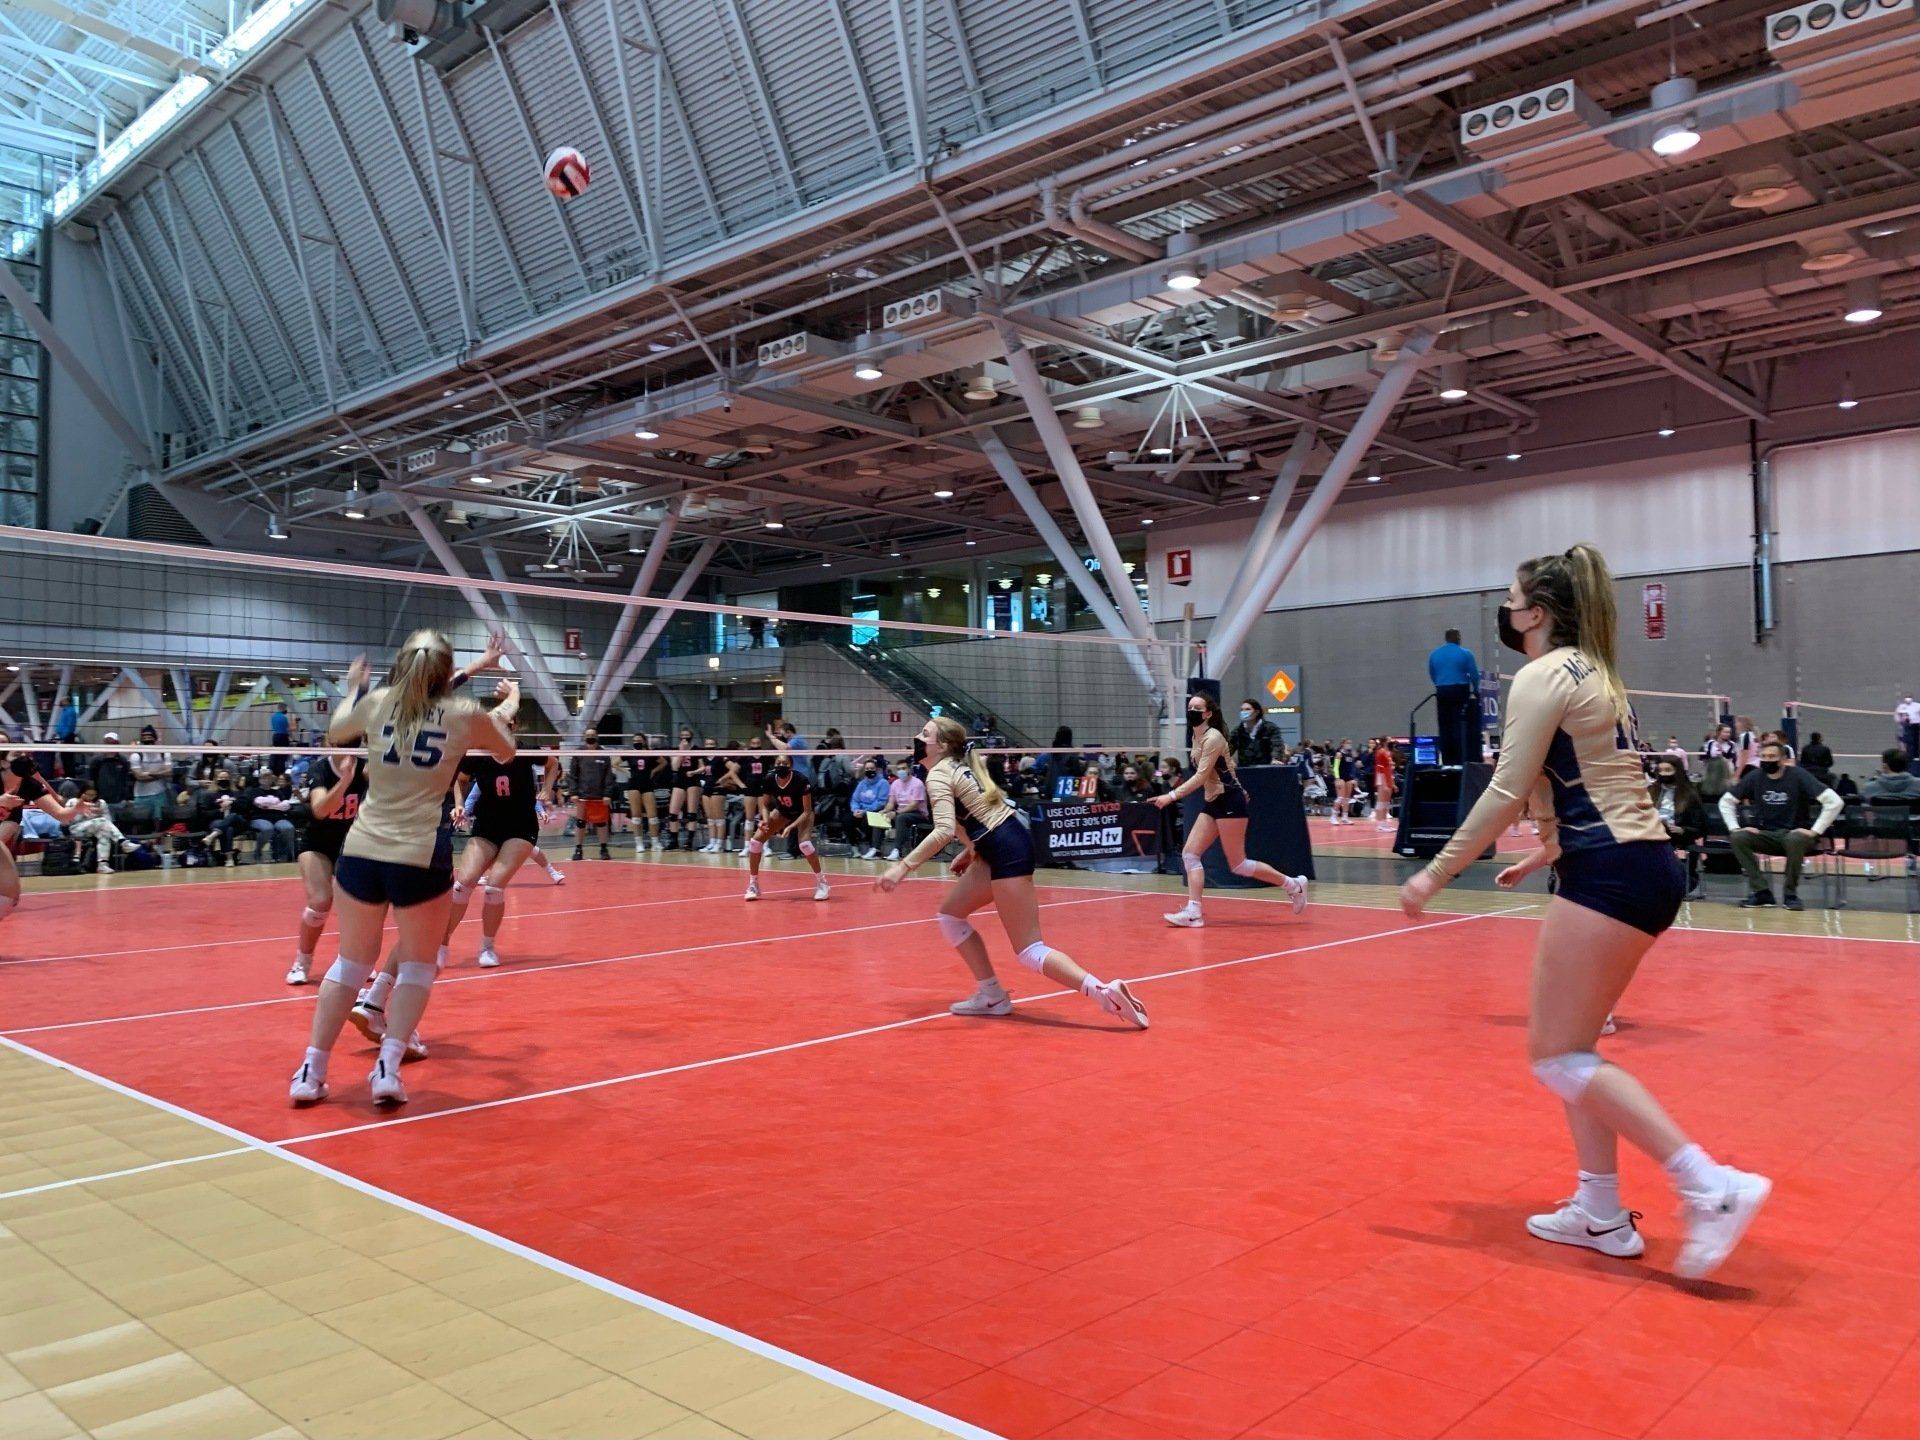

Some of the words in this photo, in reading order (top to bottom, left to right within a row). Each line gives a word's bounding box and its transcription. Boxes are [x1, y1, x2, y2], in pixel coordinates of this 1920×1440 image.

[1272, 678, 1290, 695] A
[1483, 696, 1499, 717] 10
[1057, 778, 1074, 795] 13
[1081, 777, 1098, 795] 10
[1047, 807, 1064, 818] USE
[1064, 805, 1091, 816] CODE:
[1050, 820, 1063, 829] TO
[1063, 818, 1081, 828] GET
[1082, 816, 1100, 827] 30%
[1101, 814, 1118, 825] OFF
[1049, 830, 1102, 848] BALLER
